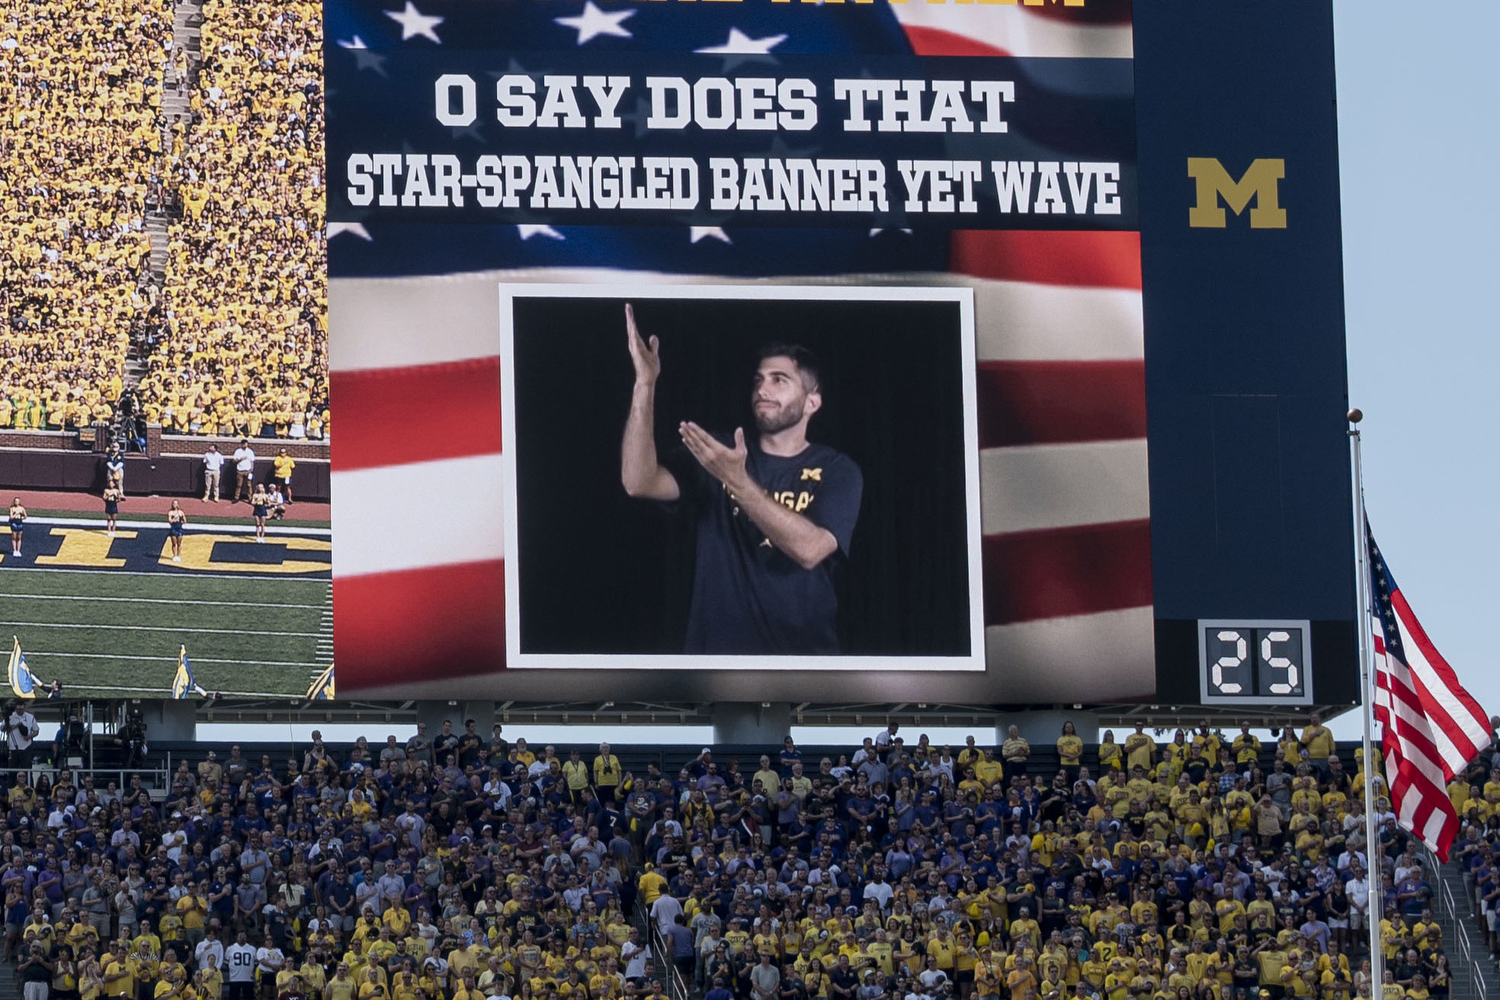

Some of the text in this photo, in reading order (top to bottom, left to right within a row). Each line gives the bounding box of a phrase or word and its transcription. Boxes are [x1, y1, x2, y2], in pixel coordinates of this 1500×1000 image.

[434, 73, 1016, 134] O SAY DOES THAT
[347, 153, 1122, 216] STAR-SPANGLED BANNER YET WAVE
[1187, 157, 1287, 229] M
[800, 467, 822, 481] M
[1211, 630, 1298, 694] 25
[233, 952, 252, 966] 90
[1102, 947, 1111, 962] 2
